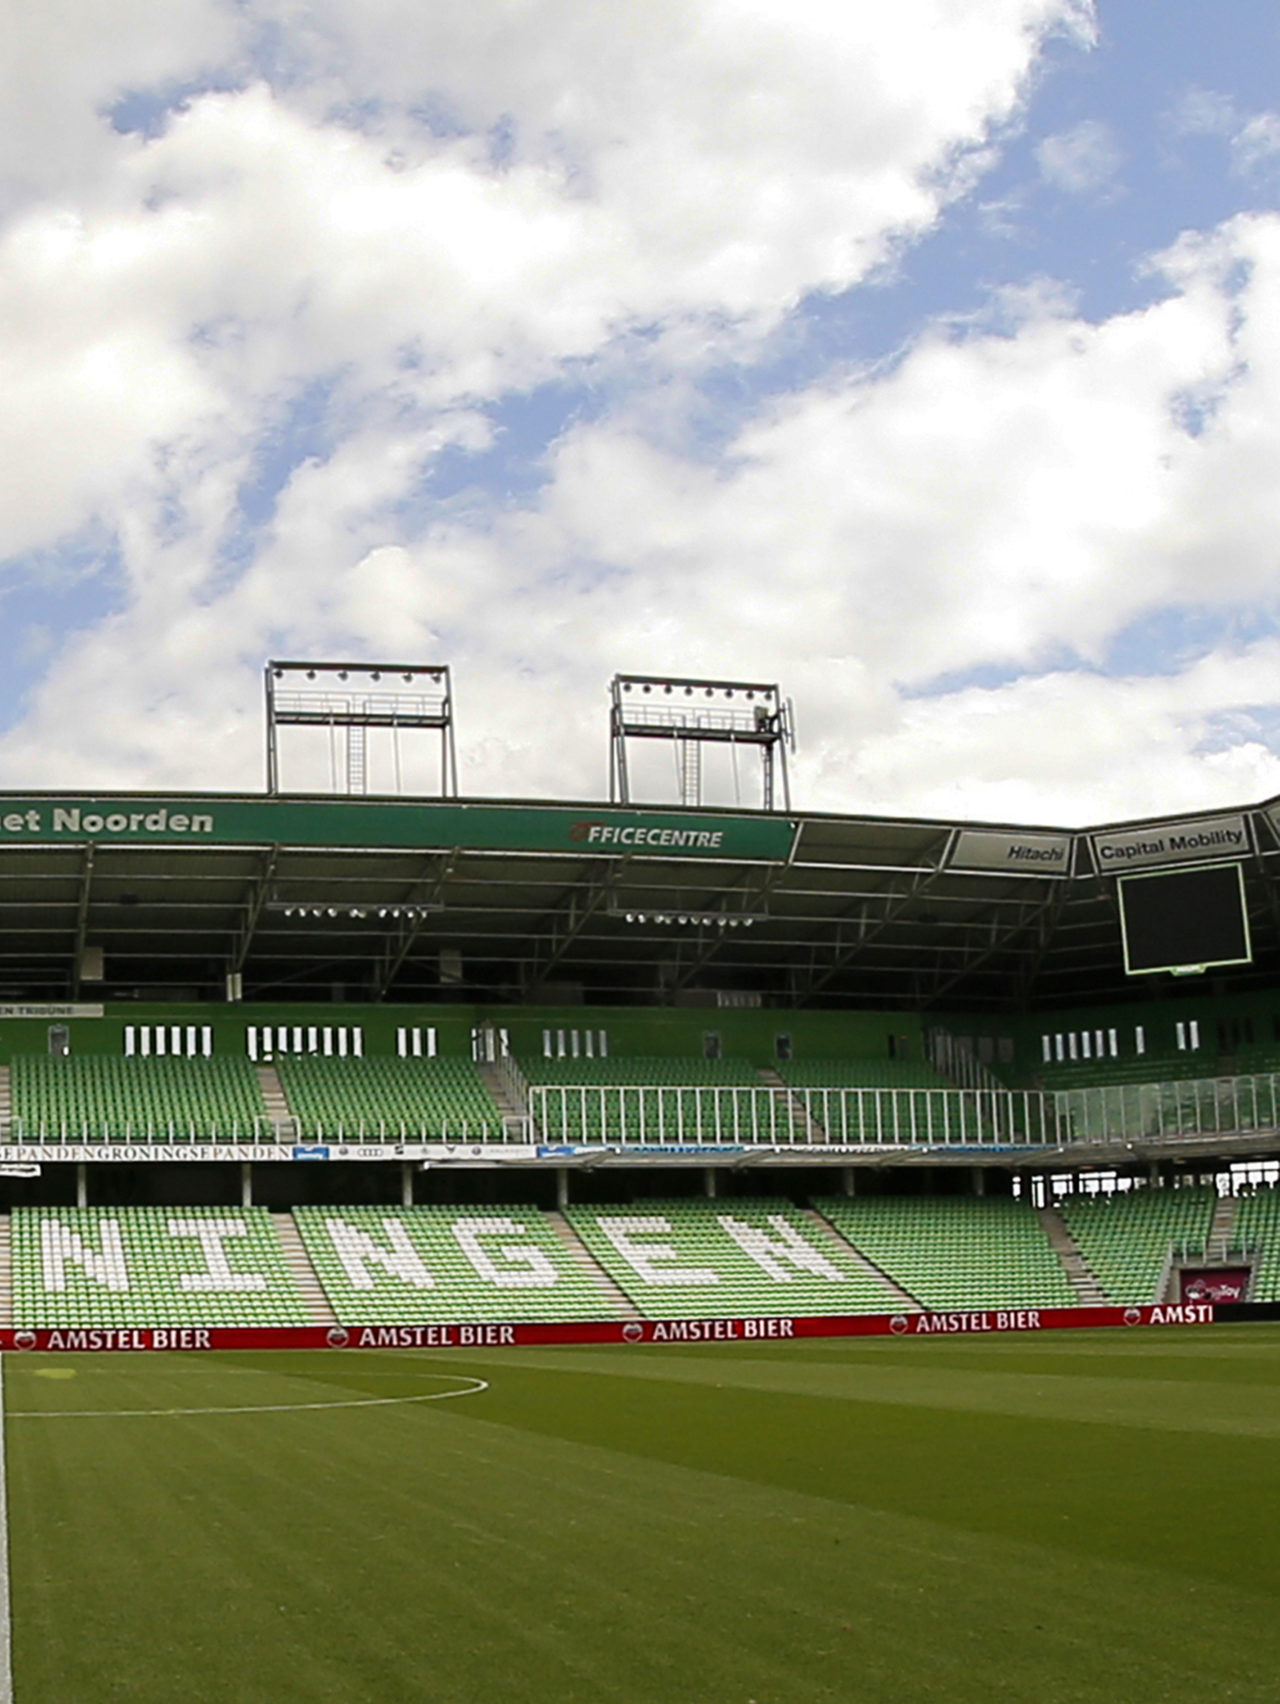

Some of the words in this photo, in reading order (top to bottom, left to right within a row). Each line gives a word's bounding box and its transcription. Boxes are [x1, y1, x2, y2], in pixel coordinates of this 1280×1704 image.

[54, 808, 214, 833] Noorden
[1008, 846, 1065, 861] Hitachi
[1100, 839, 1165, 860] Capital
[1170, 828, 1243, 850] Mobility
[652, 1321, 739, 1341] AMSTEL
[744, 1318, 794, 1338] BIER
[915, 1313, 993, 1333] AMSTEL
[997, 1311, 1041, 1330] BIER
[47, 1330, 145, 1349] AMSTEL
[153, 1330, 210, 1349] BIER
[358, 1327, 455, 1346] AMSTEL
[460, 1325, 516, 1345] BIER
